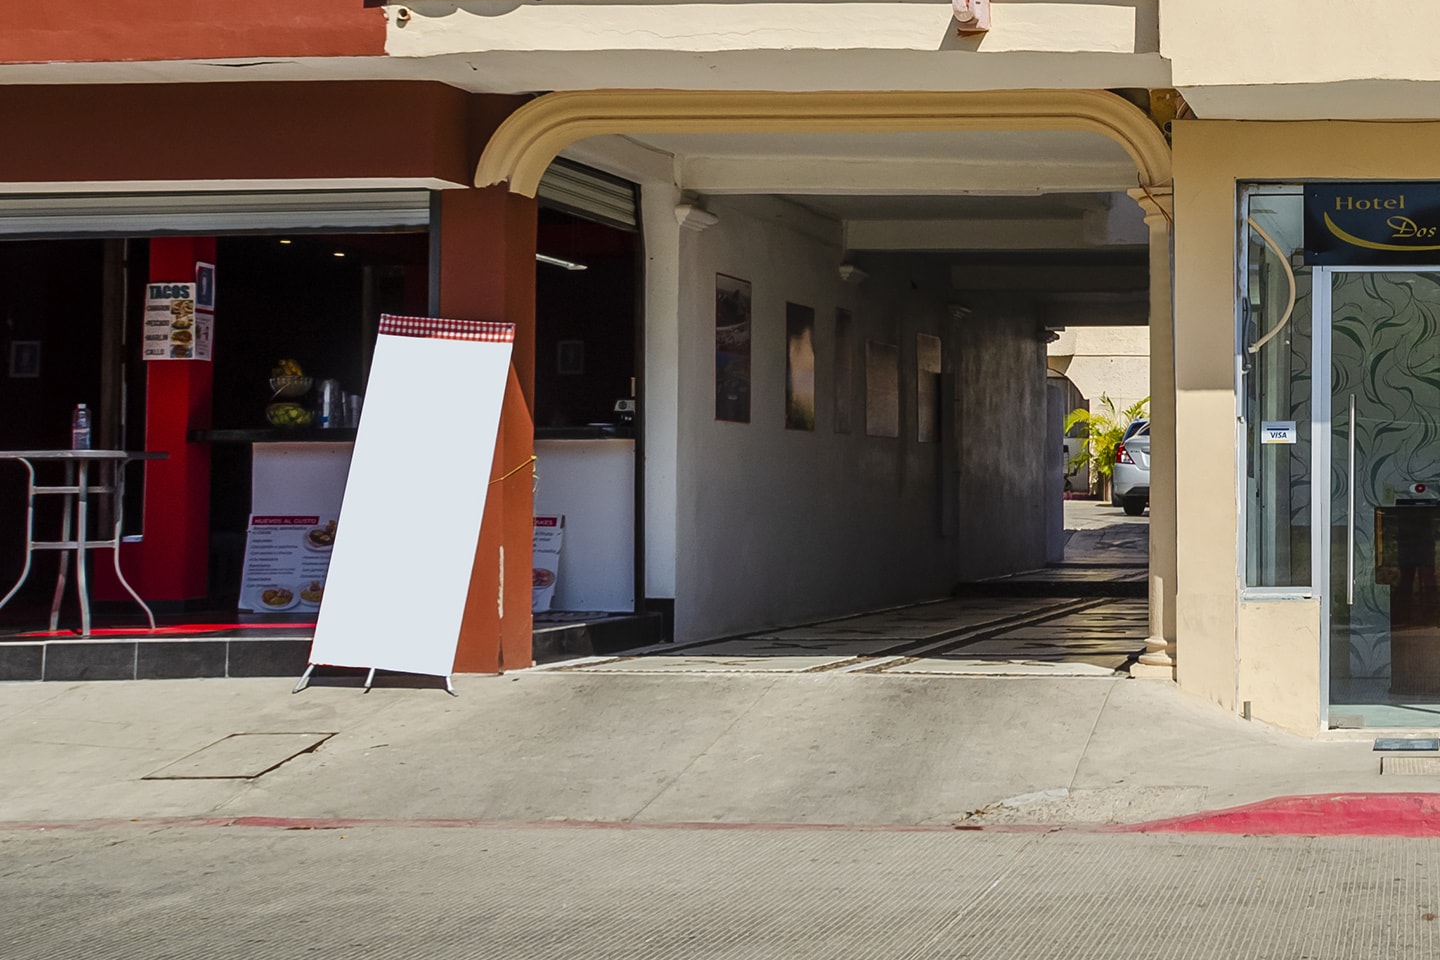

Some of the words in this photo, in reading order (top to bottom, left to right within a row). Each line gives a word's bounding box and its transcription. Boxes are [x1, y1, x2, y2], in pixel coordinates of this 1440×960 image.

[1335, 194, 1405, 210] Hotel
[1386, 215, 1437, 239] Dos
[148, 284, 191, 300] TACOS
